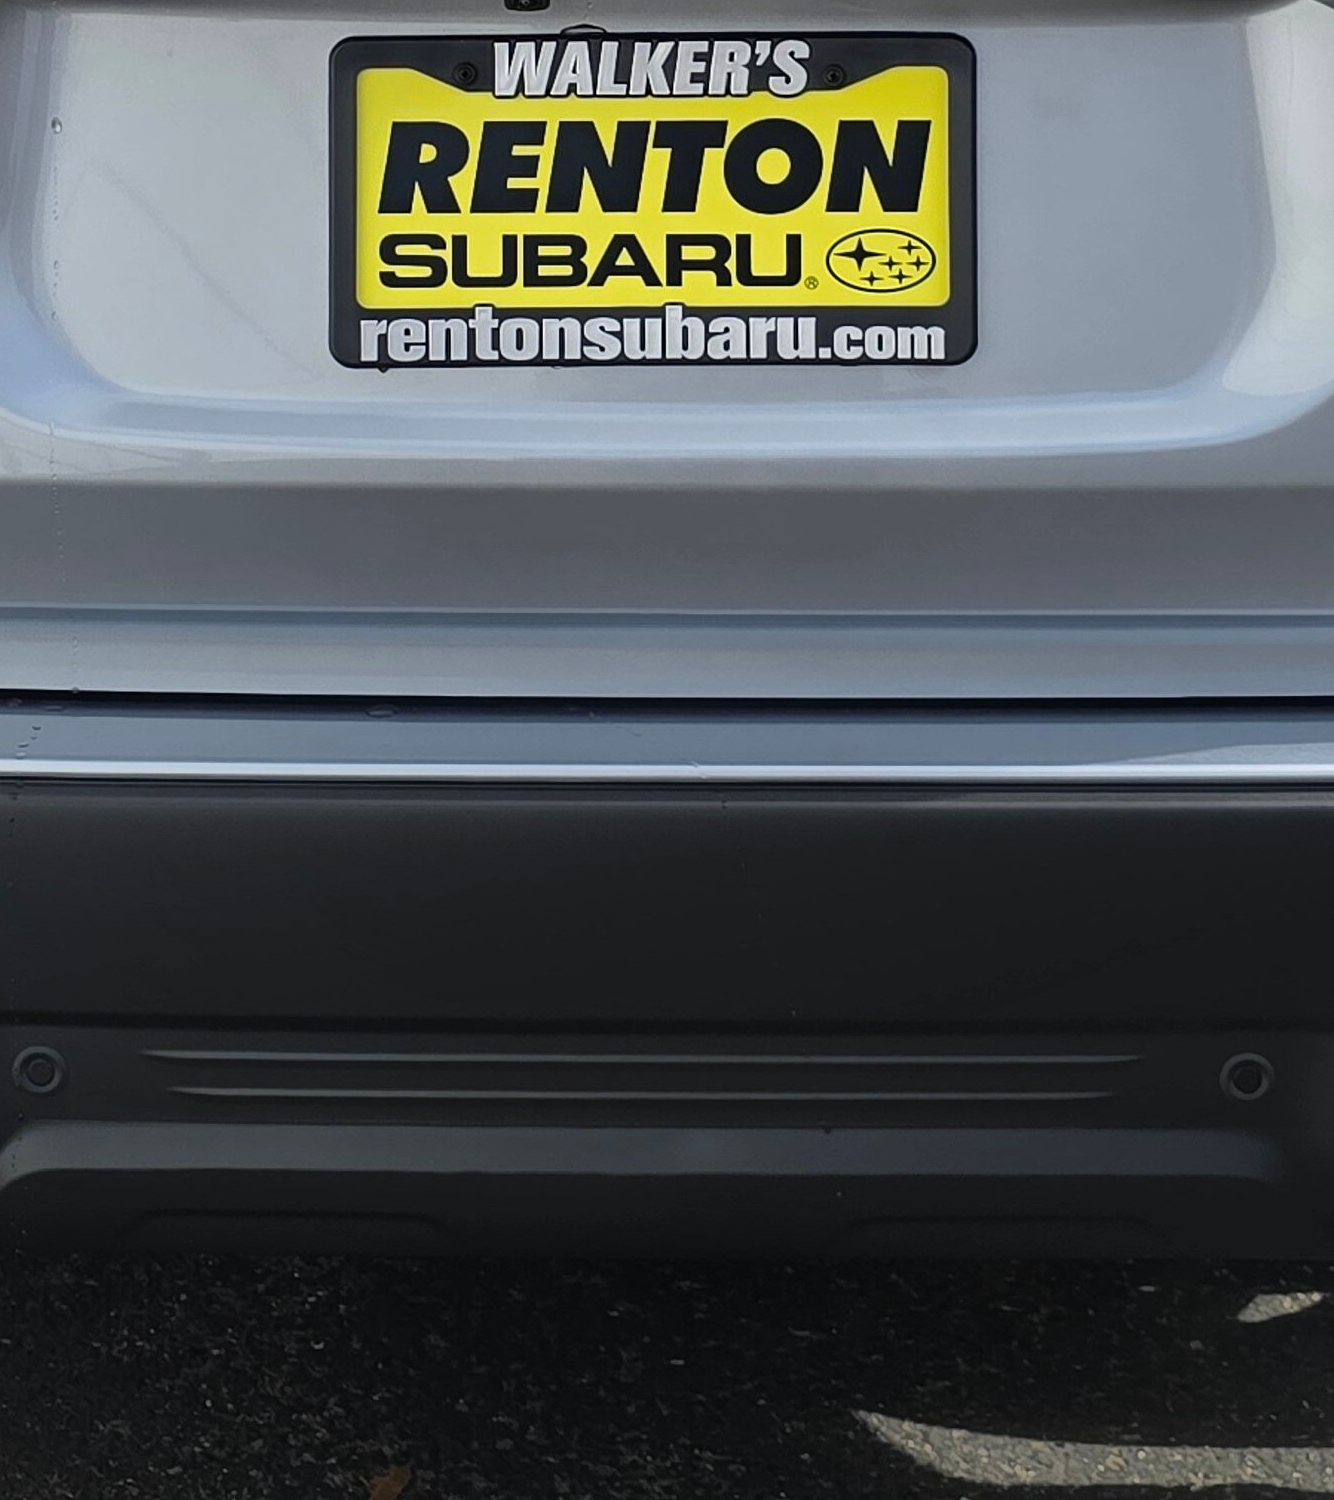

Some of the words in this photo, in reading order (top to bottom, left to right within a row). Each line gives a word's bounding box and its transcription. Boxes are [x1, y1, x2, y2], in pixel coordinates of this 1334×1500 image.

[492, 39, 810, 98] WALKER'S
[377, 117, 932, 214] RENTON
[377, 232, 803, 288] SUBARU
[359, 305, 947, 363] rentonsubaru.com
